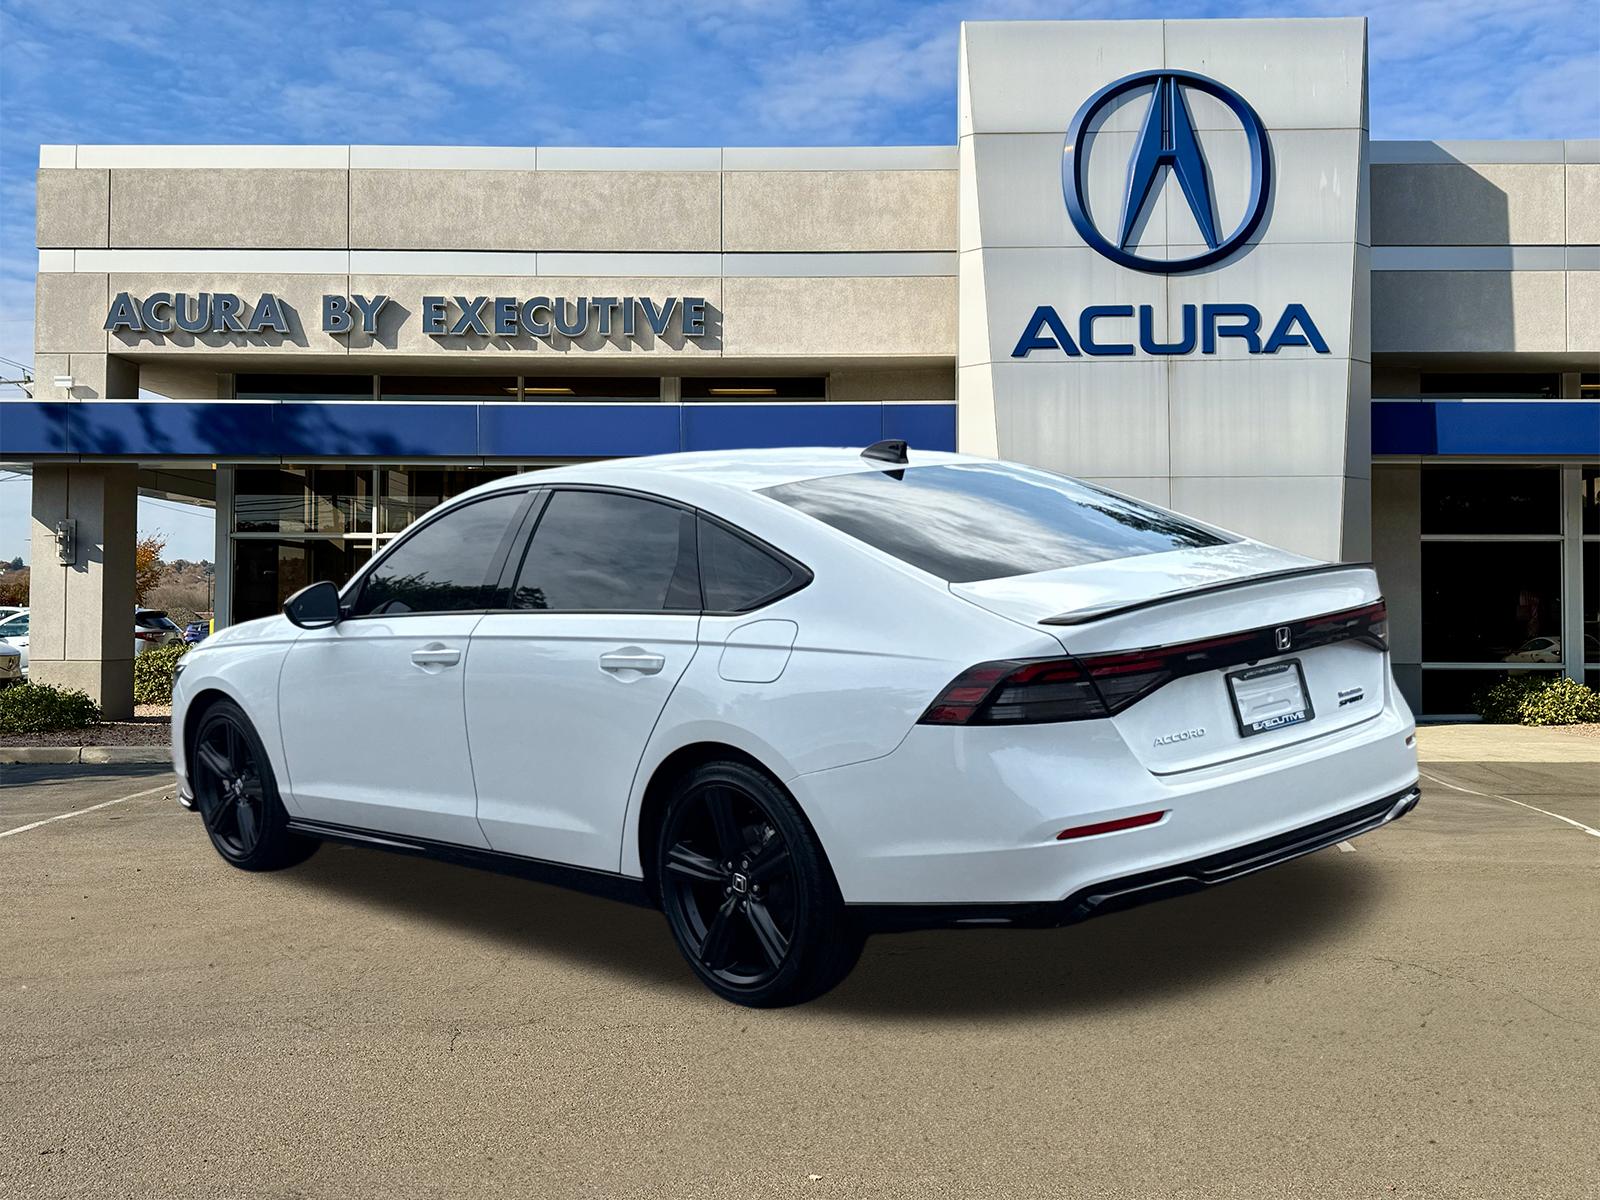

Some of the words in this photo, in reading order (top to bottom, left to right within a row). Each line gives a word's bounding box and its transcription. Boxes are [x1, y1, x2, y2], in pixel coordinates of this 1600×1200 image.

[103, 291, 290, 334] ACURA
[322, 293, 390, 335] BY
[421, 295, 706, 337] EXECUTIVE
[1010, 303, 1332, 357] ACURA
[1252, 711, 1306, 731] EXECUTIVE
[1152, 728, 1206, 748] ACCORD
